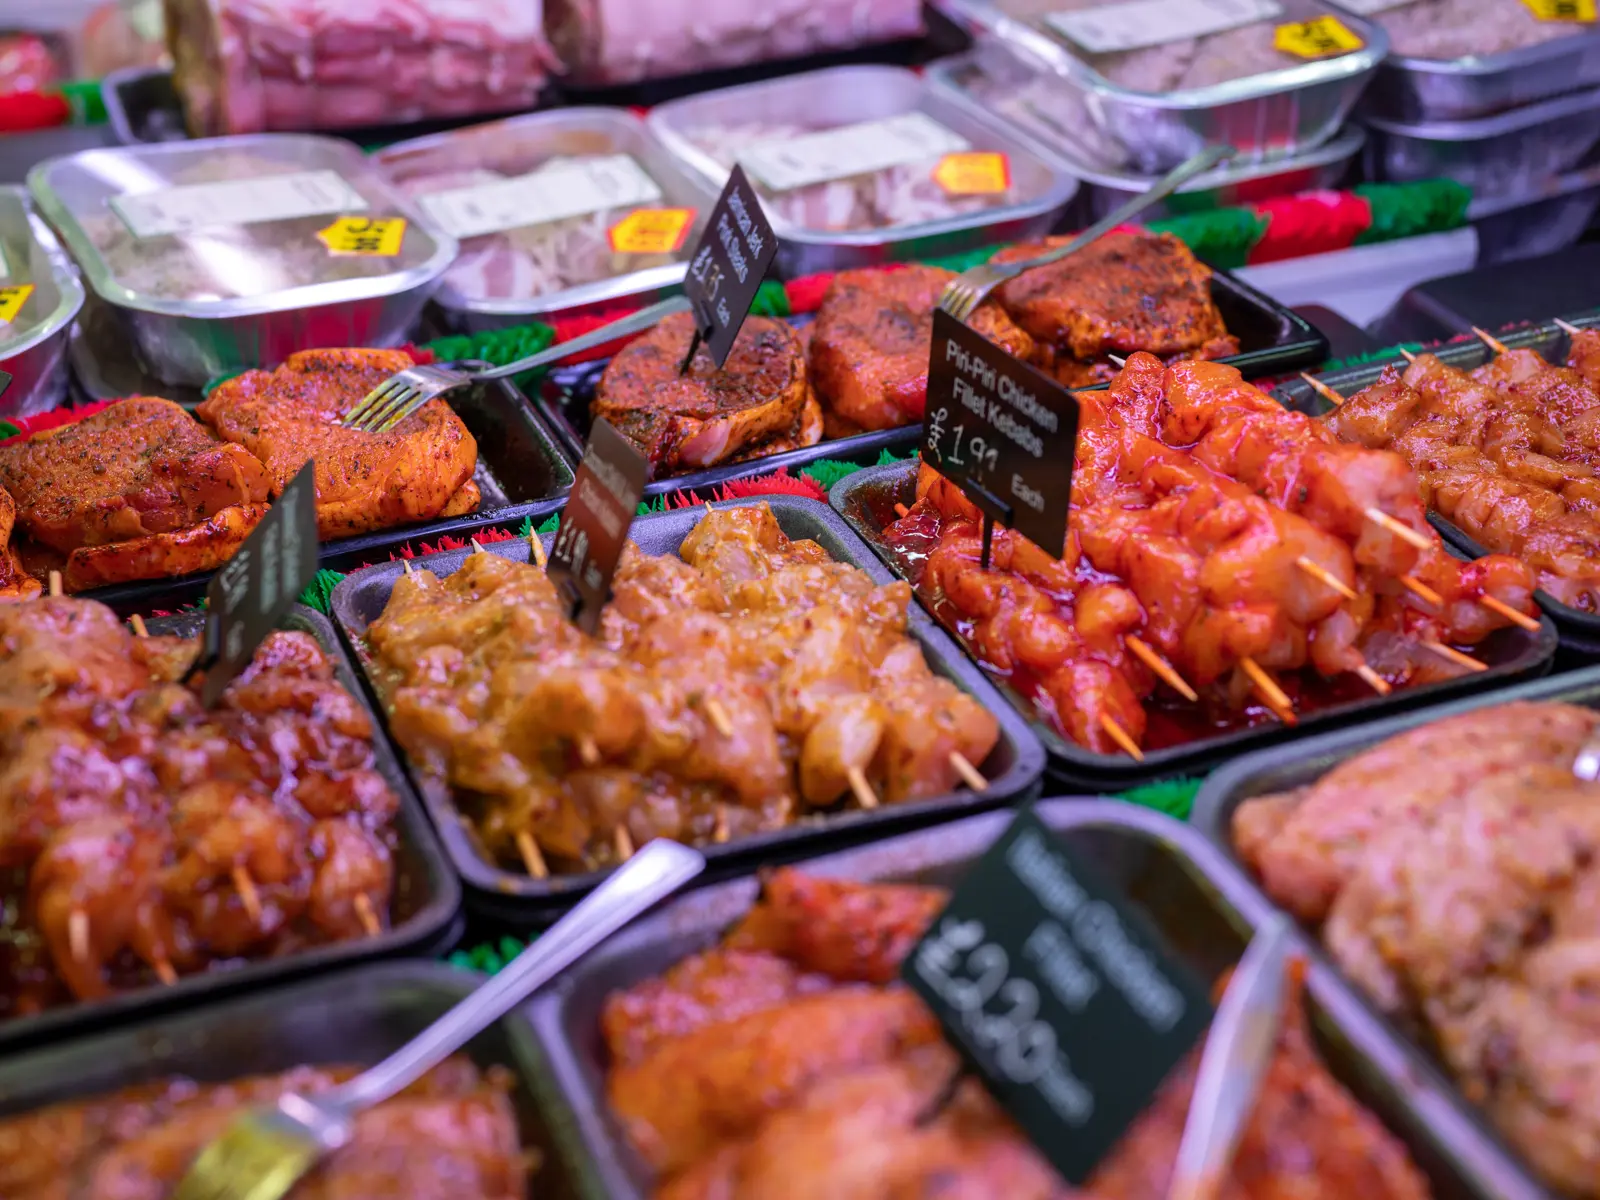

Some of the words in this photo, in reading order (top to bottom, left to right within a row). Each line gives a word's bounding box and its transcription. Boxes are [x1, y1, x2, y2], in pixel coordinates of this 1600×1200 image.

[946, 338, 996, 390] Piri-Piri
[998, 375, 1059, 434] Chicken
[953, 377, 987, 420] Fillet
[987, 400, 1044, 459] Kebabs
[1011, 473, 1046, 513] Each
